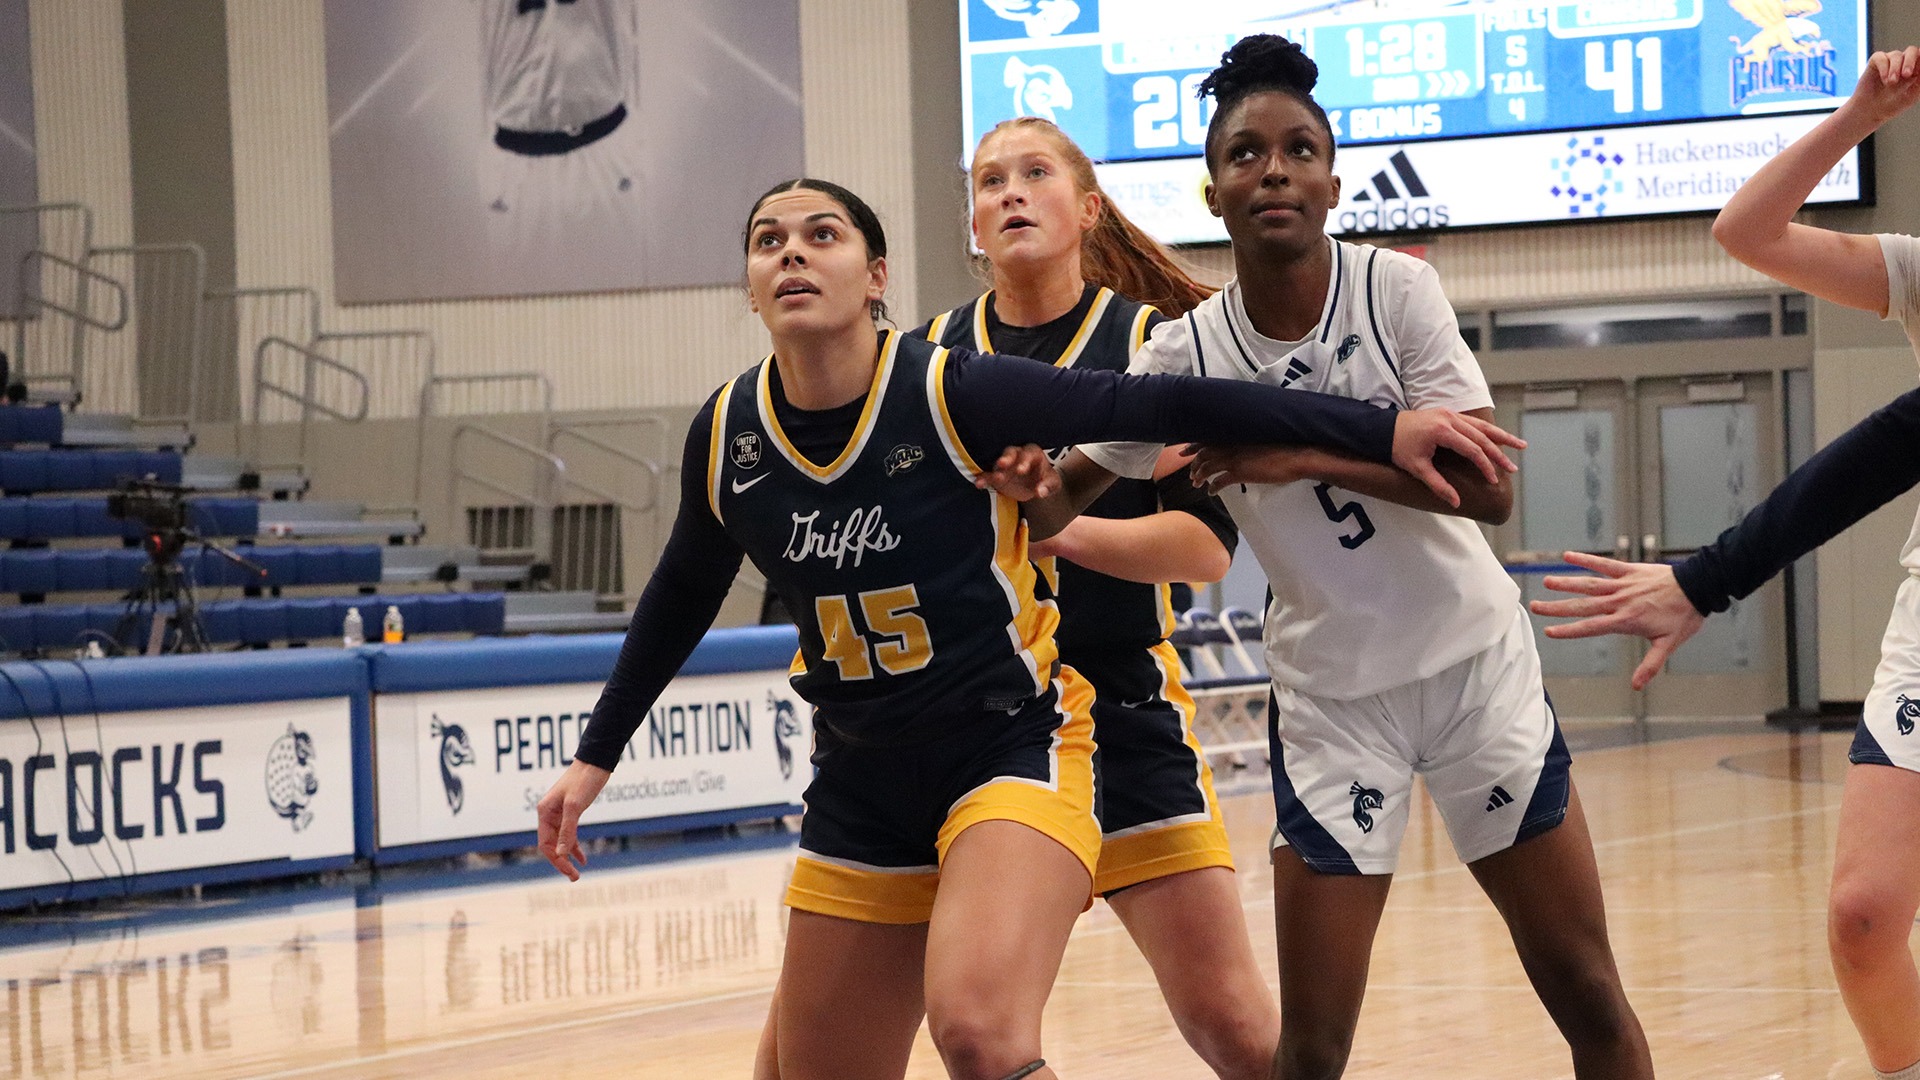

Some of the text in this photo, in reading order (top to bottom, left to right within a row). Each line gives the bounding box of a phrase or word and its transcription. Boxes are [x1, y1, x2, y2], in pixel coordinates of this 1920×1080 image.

[1345, 22, 1447, 77] 1:28
[1585, 36, 1663, 114] 41
[1133, 72, 1219, 149] 20
[1350, 104, 1442, 139] BONUS
[1507, 97, 1526, 122] 4
[1635, 133, 1789, 165] Hackensack
[1339, 200, 1450, 232] adidas
[736, 435, 757, 446] UNITED
[736, 451, 758, 463] JUSTICE
[741, 444, 752, 454] FOR
[783, 505, 901, 569] Griffs
[1313, 482, 1376, 550] 5
[815, 583, 934, 681] 45
[650, 700, 751, 758] NATION
